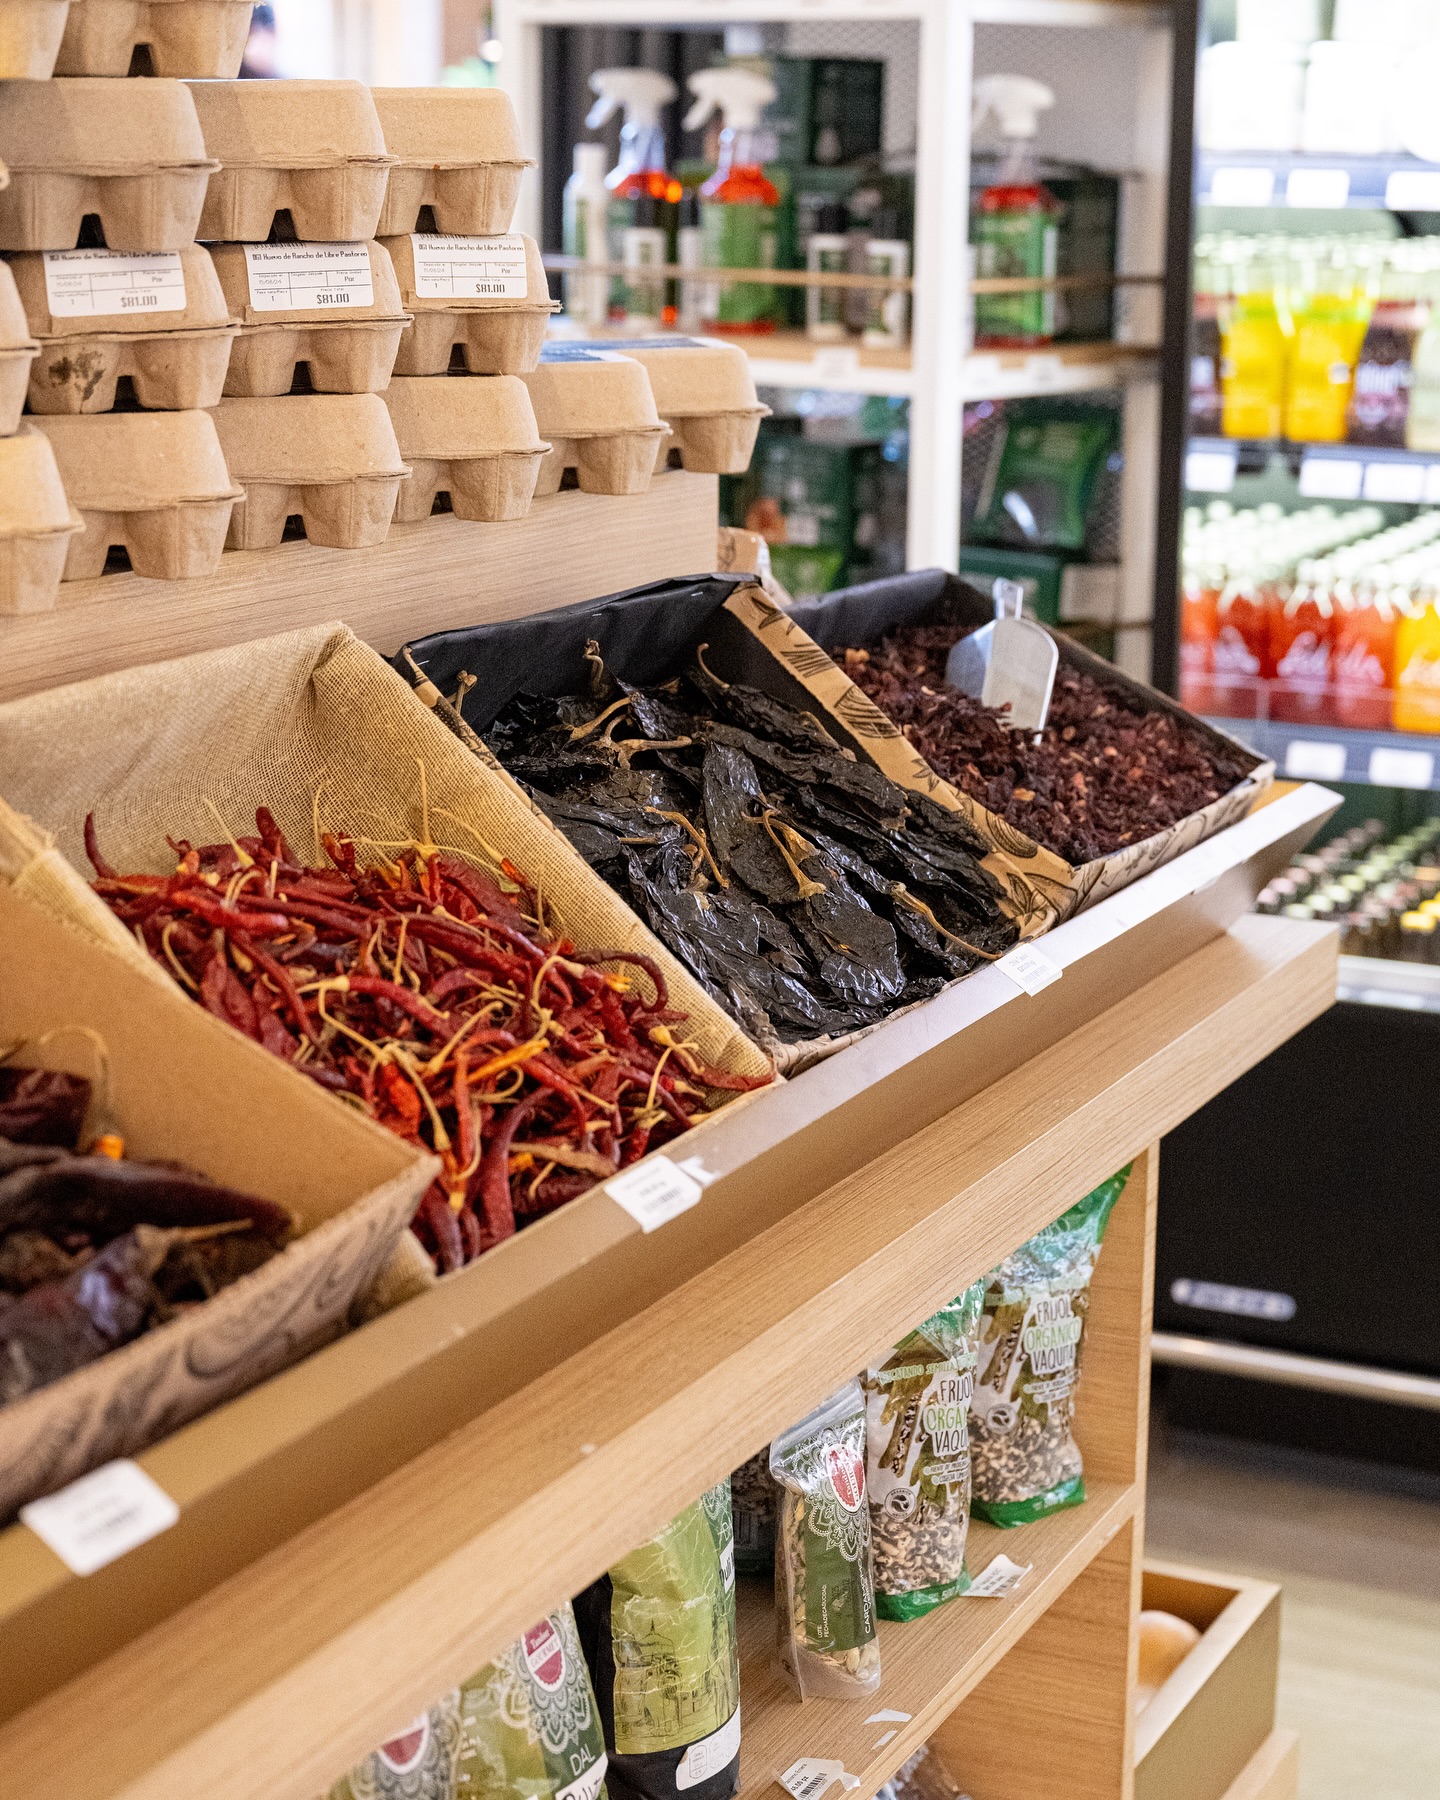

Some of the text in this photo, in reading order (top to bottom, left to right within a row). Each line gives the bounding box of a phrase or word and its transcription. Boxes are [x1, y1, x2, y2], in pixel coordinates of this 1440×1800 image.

[263, 252, 282, 260] Huevo
[283, 252, 292, 260] de
[292, 251, 315, 260] Rancho
[315, 251, 324, 259] de
[324, 251, 340, 259] Libre
[340, 250, 368, 258] Pastoreo
[475, 284, 505, 293] $81.00
[120, 295, 158, 308] $81.00
[316, 293, 350, 305] $81.00
[1036, 1298, 1071, 1323] FRIJOL
[925, 1359, 957, 1375] SEMILLA
[839, 1463, 853, 1499] Tandoo
[858, 1558, 872, 1634] CARDAMOMO
[569, 1743, 596, 1777] DAL
